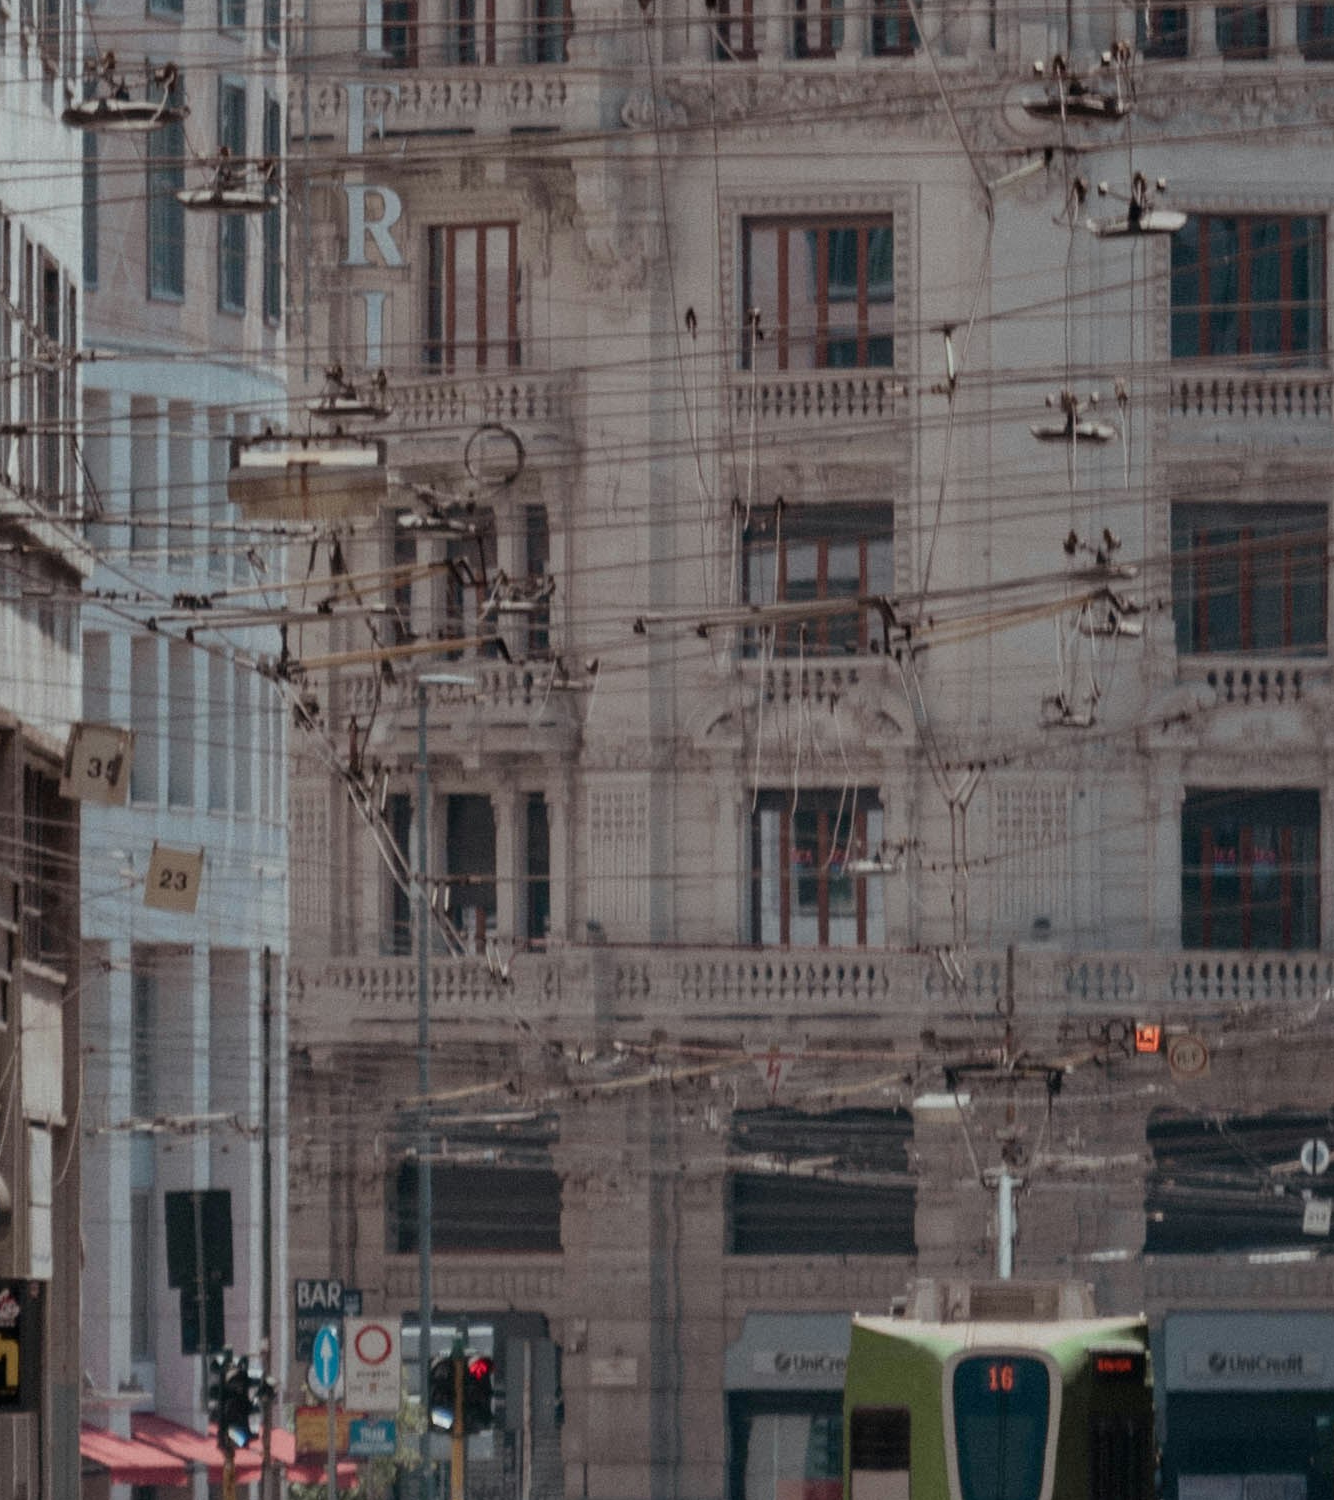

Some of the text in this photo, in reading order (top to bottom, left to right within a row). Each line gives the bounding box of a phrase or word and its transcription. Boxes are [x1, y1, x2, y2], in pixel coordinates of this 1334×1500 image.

[158, 867, 188, 891] 23
[298, 1280, 342, 1309] BAR
[1229, 1352, 1304, 1374] UniCredit
[988, 1364, 1014, 1392] 16
